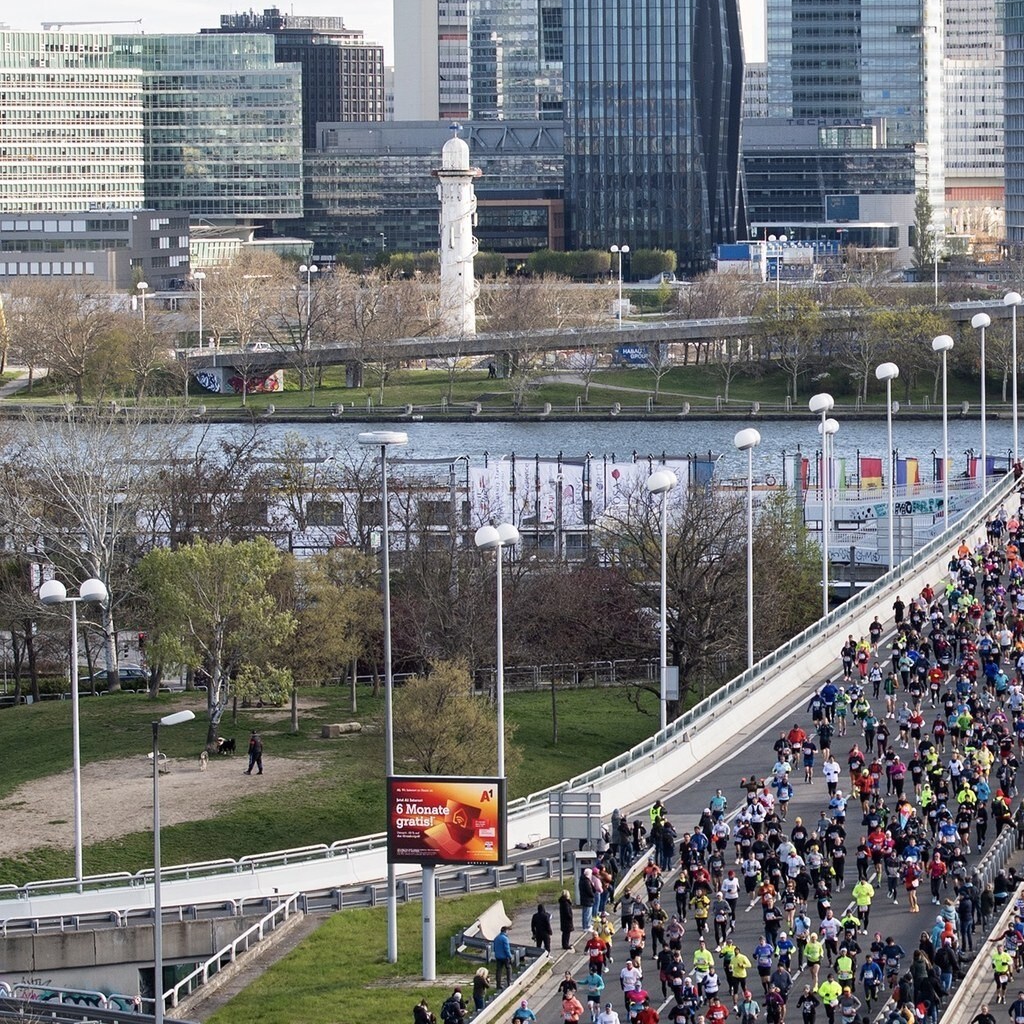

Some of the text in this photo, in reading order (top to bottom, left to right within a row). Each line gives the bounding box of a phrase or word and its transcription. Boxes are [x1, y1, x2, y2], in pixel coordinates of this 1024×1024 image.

[786, 118, 873, 126] TECH GATE
[480, 789, 493, 803] A1
[396, 803, 450, 815] 6 Monate
[396, 816, 434, 829] gratis!
